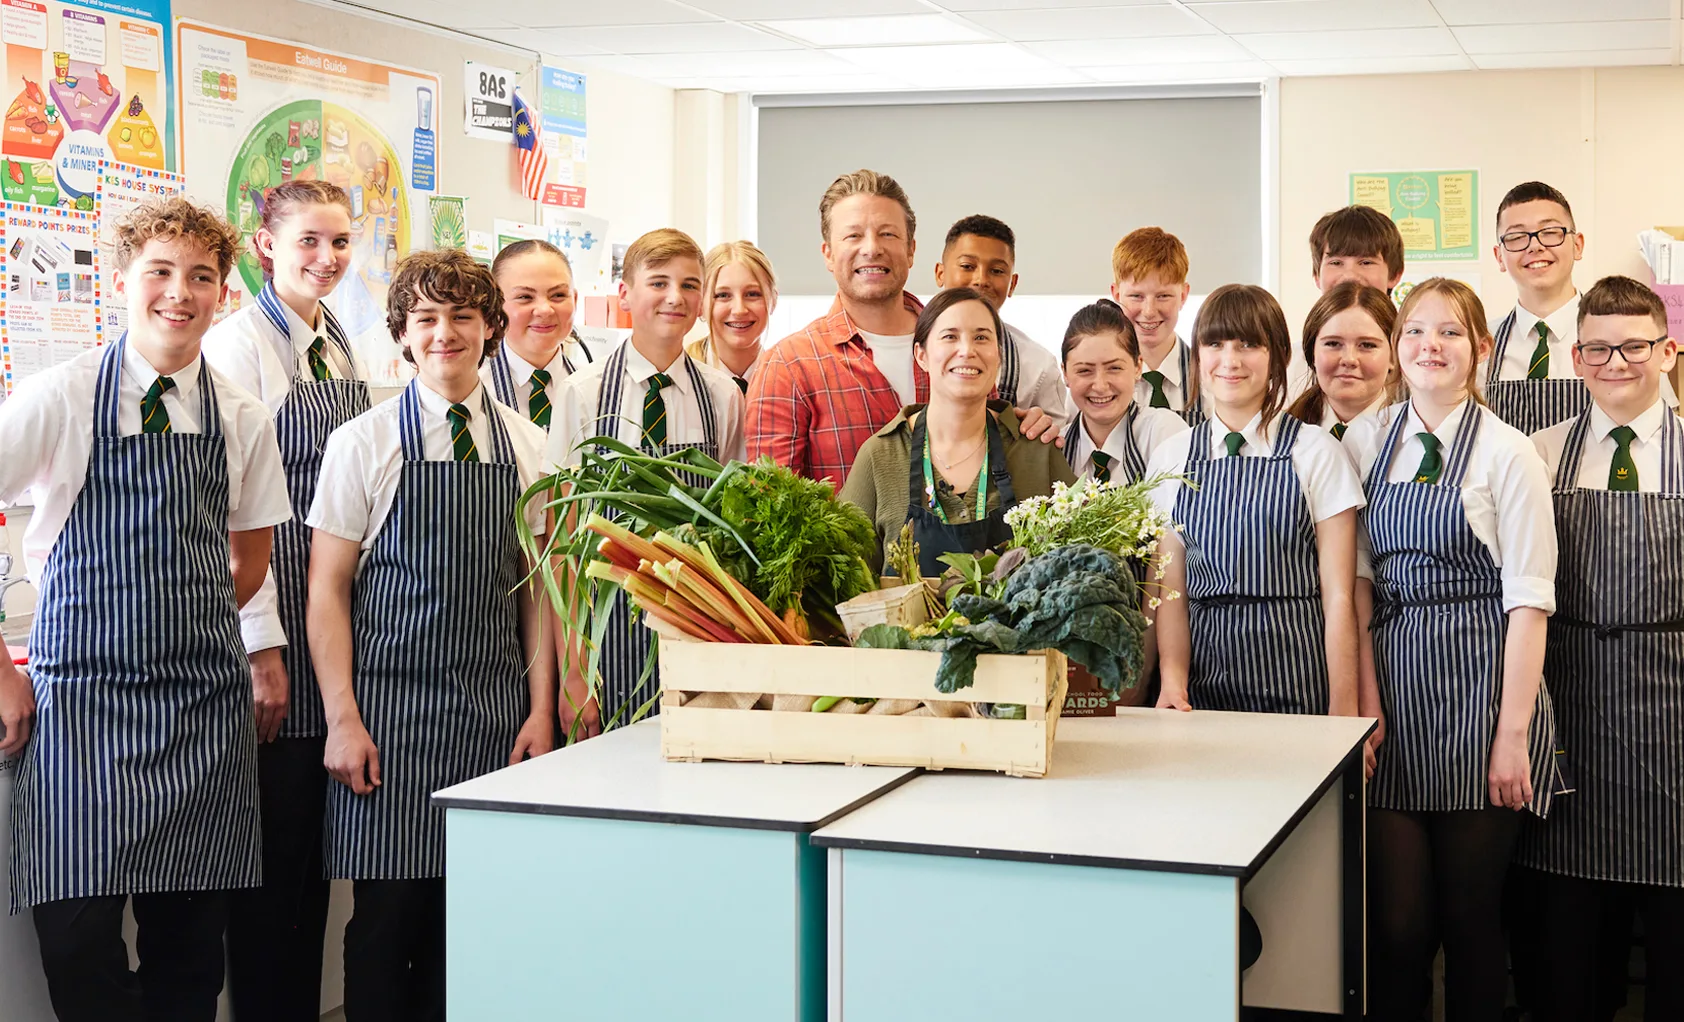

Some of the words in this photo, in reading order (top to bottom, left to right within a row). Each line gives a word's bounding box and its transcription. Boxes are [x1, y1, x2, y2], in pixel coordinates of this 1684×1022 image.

[75, 12, 98, 22] VITAMINS
[295, 51, 322, 68] Eatwell
[323, 58, 347, 73] Guide
[480, 72, 506, 99] 8AS
[474, 104, 487, 115] THE
[473, 116, 512, 127] CHAMPIONS
[69, 144, 104, 157] VITAMINS
[62, 158, 68, 168] &
[70, 159, 96, 172] MINER
[105, 175, 119, 186] KES
[122, 179, 146, 191] HOUSE
[149, 184, 178, 196] SYSTEM
[9, 217, 36, 228] REWARD
[39, 221, 64, 232] POINTS
[67, 224, 90, 234] PRIZES
[1066, 697, 1108, 708] ARDS
